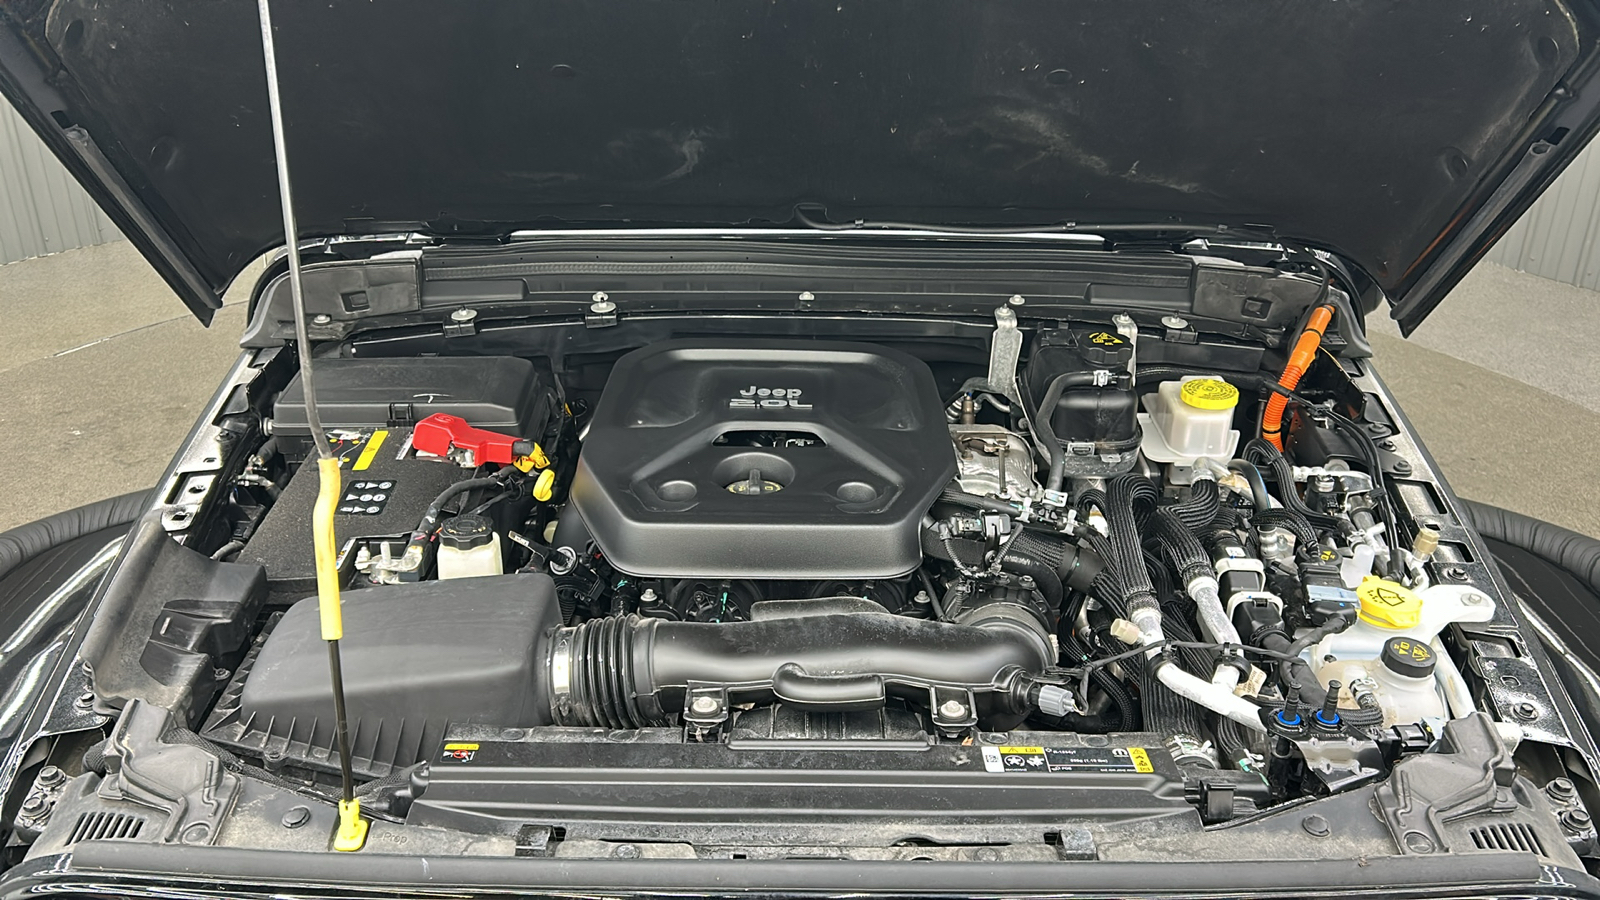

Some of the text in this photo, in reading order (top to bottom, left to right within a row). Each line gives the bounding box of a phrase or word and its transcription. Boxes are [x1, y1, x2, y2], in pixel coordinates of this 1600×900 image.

[740, 385, 802, 398] Jeep
[729, 399, 813, 409] 2.0L
[382, 831, 408, 845] Prop
